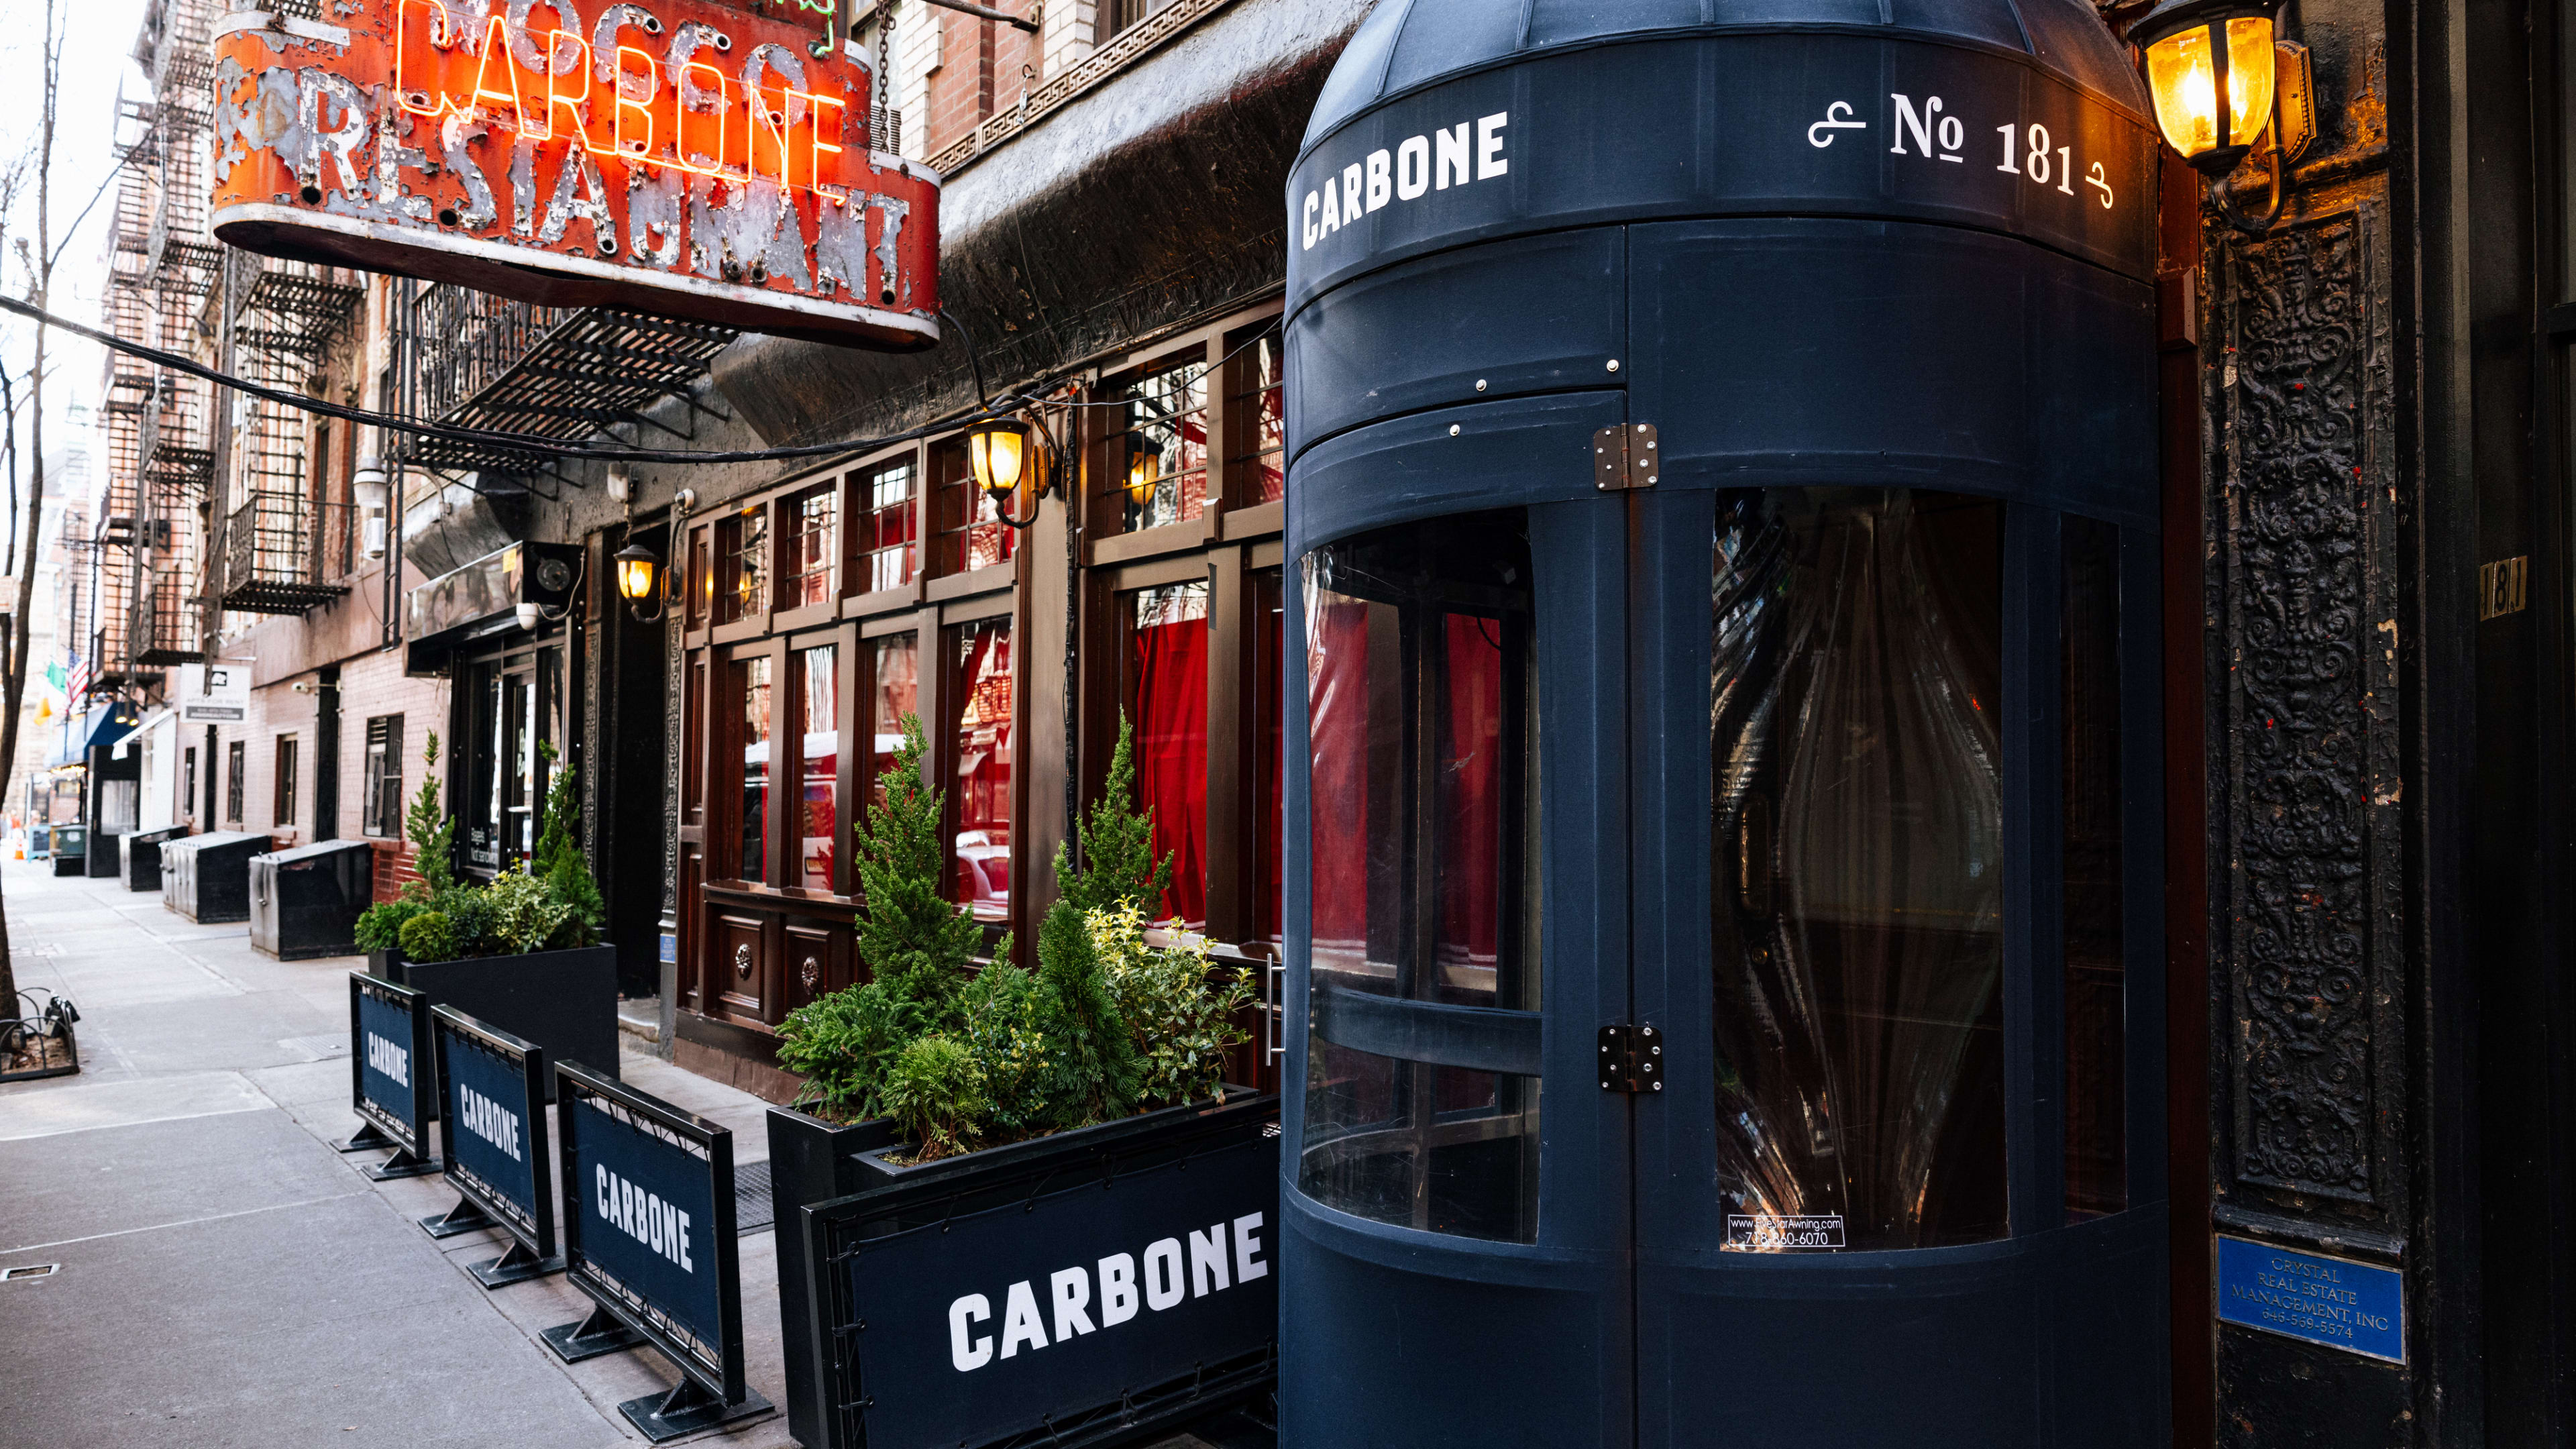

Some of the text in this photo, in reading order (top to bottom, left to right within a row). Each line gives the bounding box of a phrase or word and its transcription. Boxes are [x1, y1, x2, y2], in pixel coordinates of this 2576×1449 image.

[394, 0, 846, 207] CARBONE
[1303, 111, 1508, 251] CARBONE
[1996, 123, 2075, 196] 181
[2483, 560, 2522, 616] 181
[368, 1031, 408, 1088] CARBONE
[461, 1083, 521, 1163] CARBONE
[596, 1163, 693, 1274] CARBONE
[1730, 1218, 1841, 1232] www.FiveStarAwning.com
[1745, 1232, 1828, 1246] 718-860-6070
[949, 1210, 1269, 1373] CARBONE
[2257, 1272, 2357, 1306] REAL ESTATE
[2271, 1258, 2341, 1284] CRYSTAL
[2231, 1284, 2389, 1331] MANAGEMENT, INC
[2261, 1307, 2353, 1339] 646-569-5574
